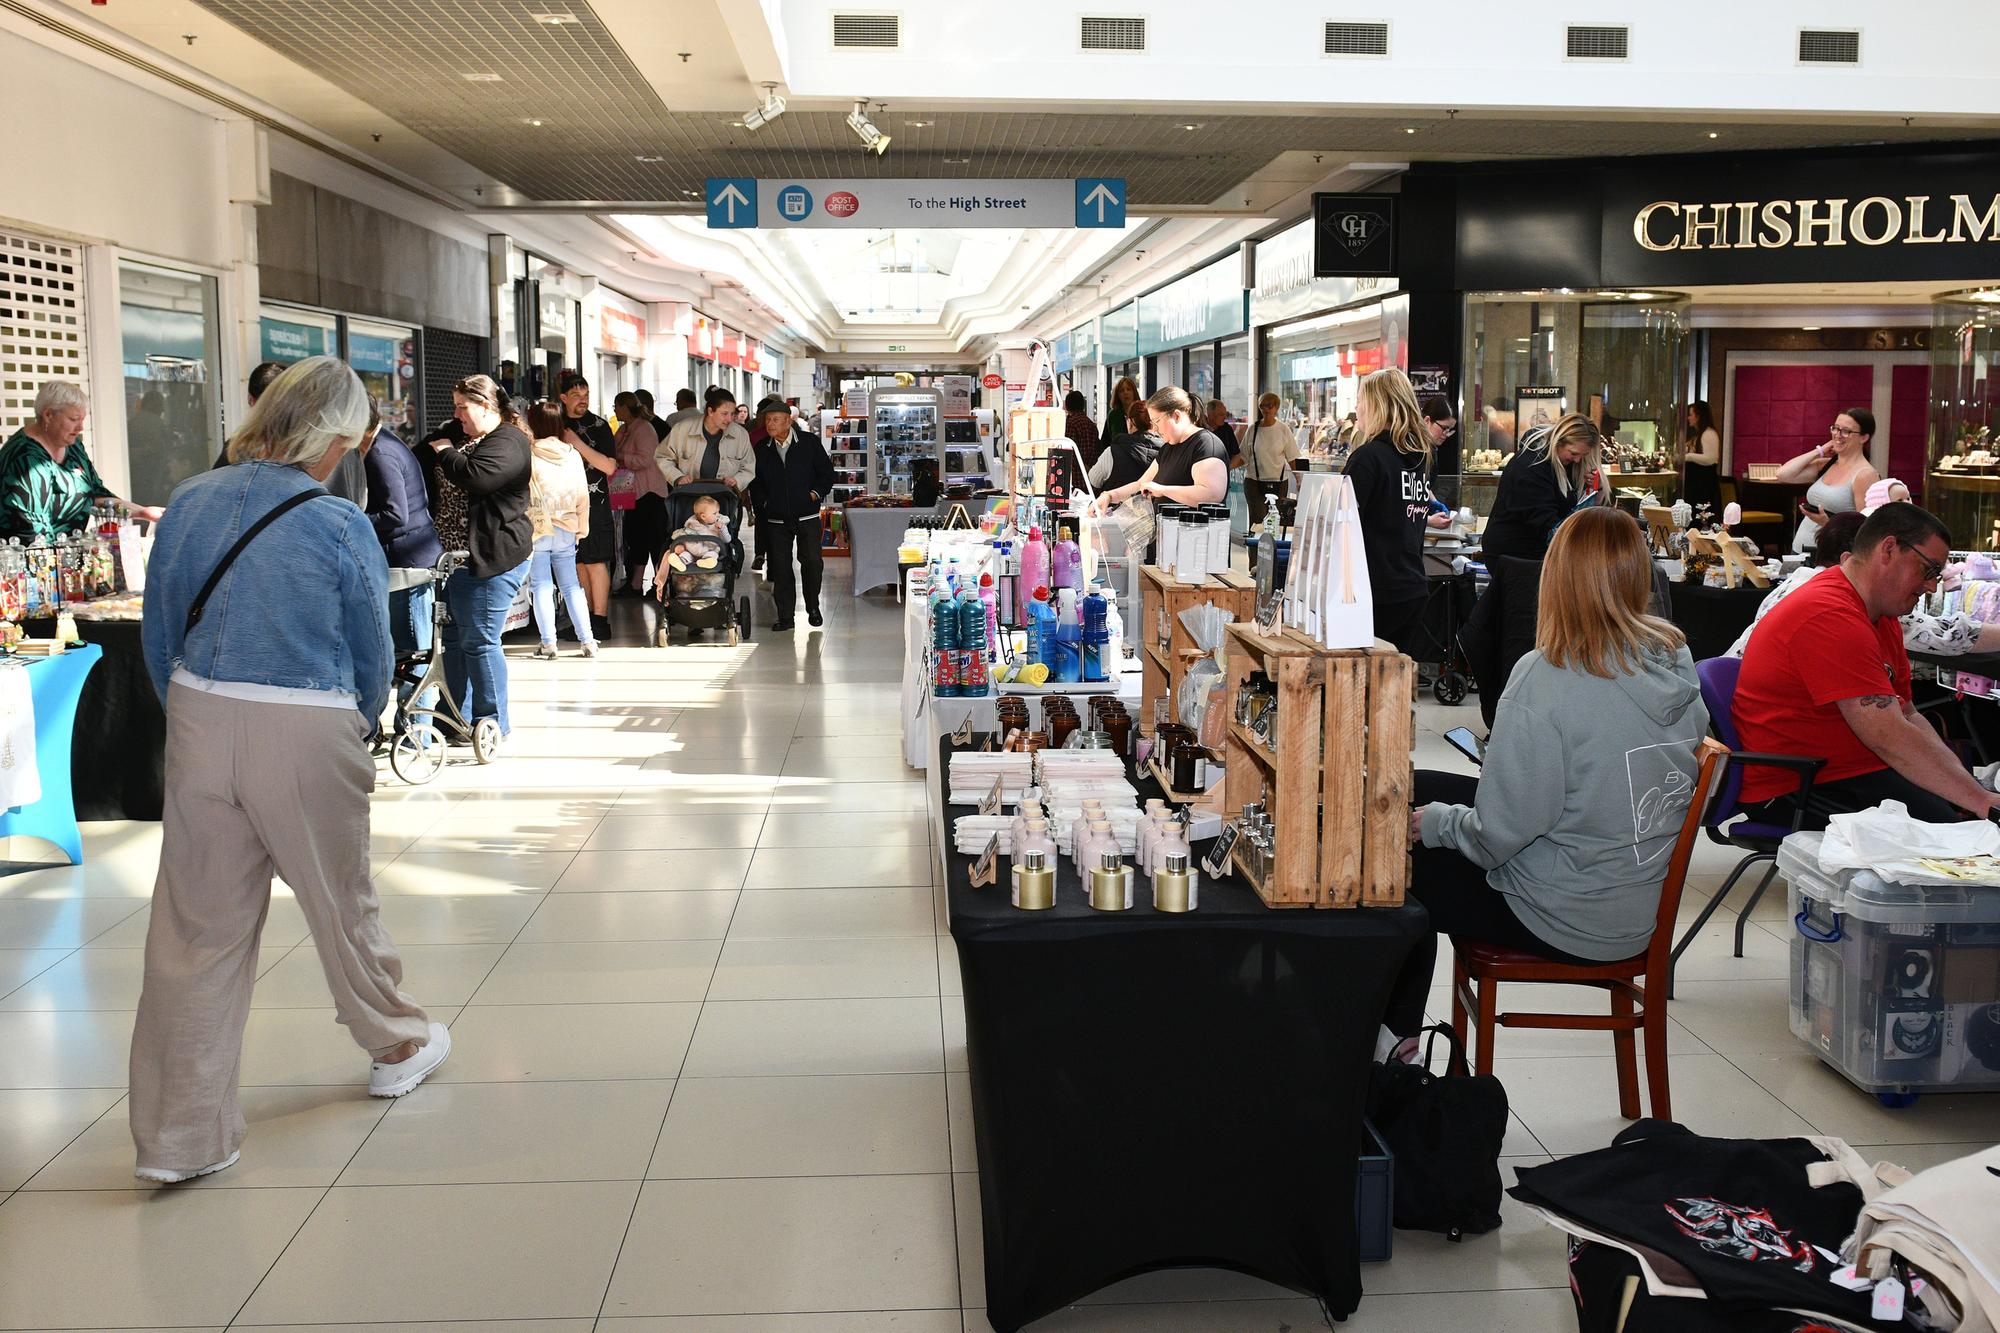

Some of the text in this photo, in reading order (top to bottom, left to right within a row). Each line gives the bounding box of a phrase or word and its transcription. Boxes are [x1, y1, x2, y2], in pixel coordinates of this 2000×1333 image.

[832, 196, 852, 204] POST
[908, 196, 1027, 212] To the High Street
[1633, 193, 2000, 251] CHISHOLM
[1348, 239, 1366, 247] 1857
[1945, 1004, 1955, 1048] BLACK
